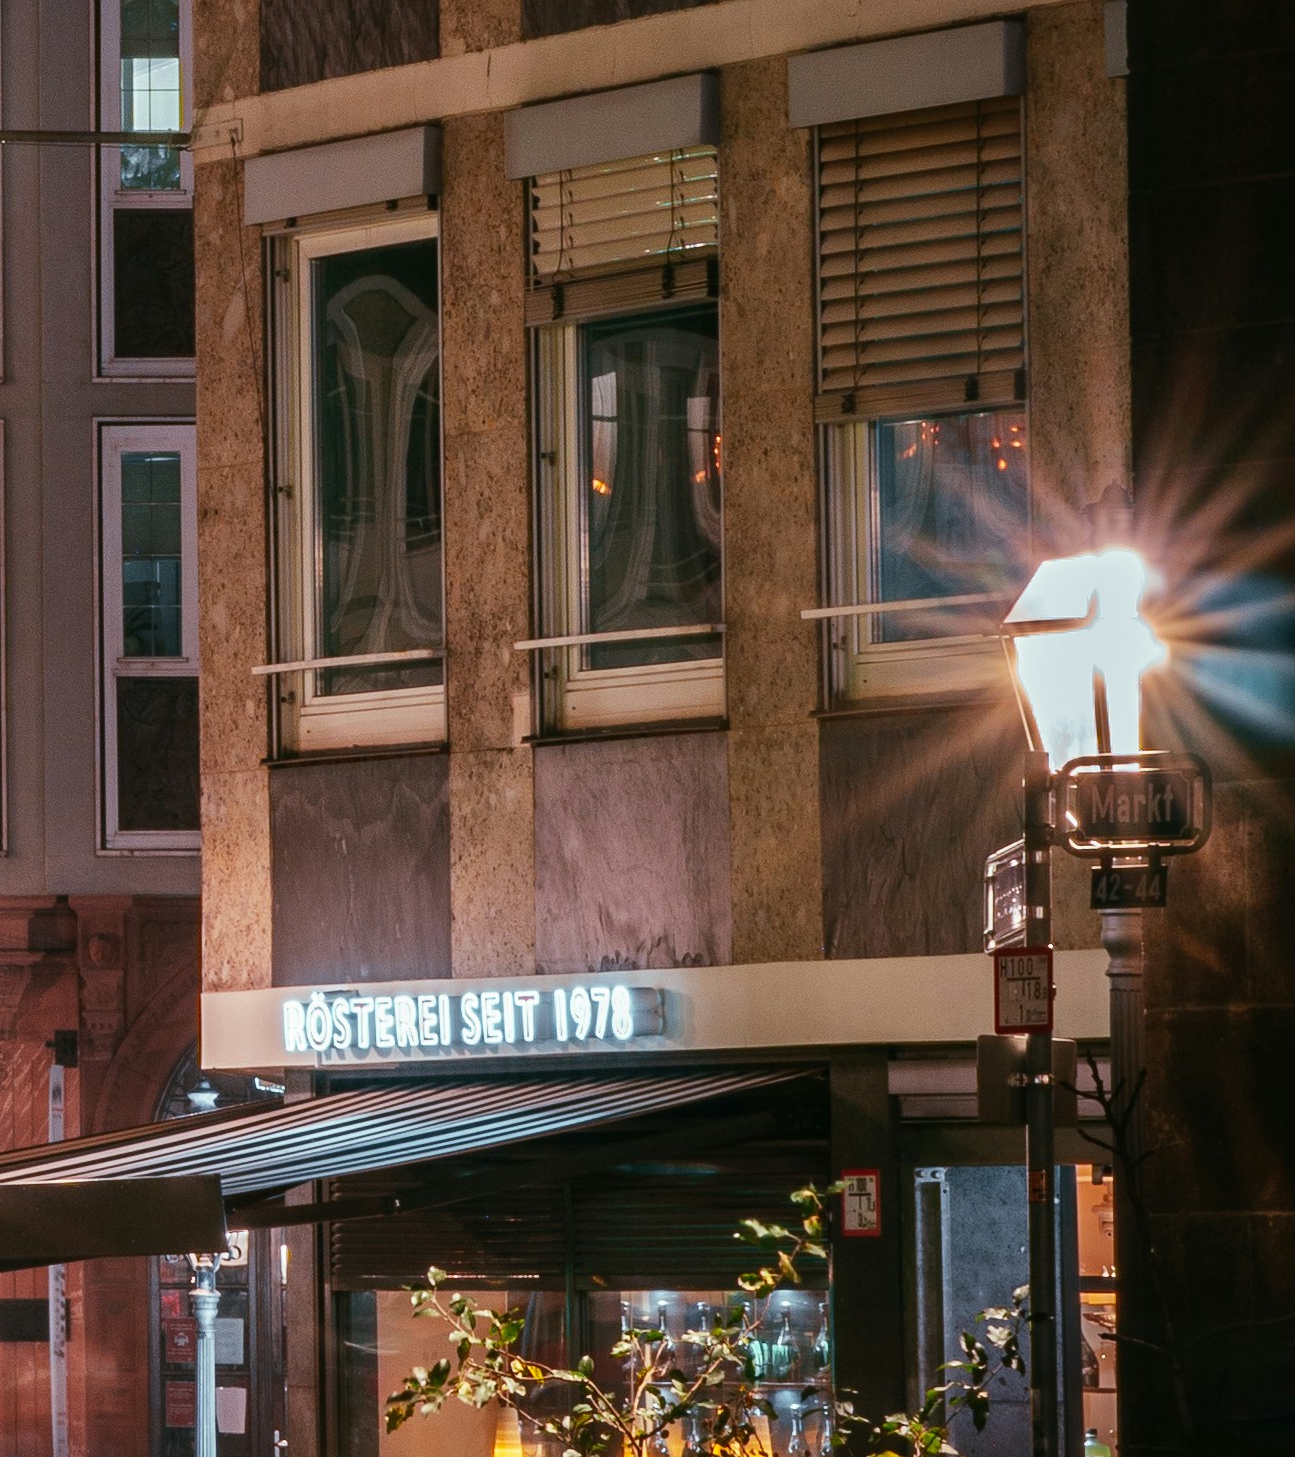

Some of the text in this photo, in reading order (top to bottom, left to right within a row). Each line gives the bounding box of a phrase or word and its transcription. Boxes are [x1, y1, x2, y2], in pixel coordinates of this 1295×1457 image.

[1091, 783, 1174, 824] Markt
[1095, 873, 1161, 903] 42-44
[283, 984, 633, 1052] RÖSTEREI SEIT 1978
